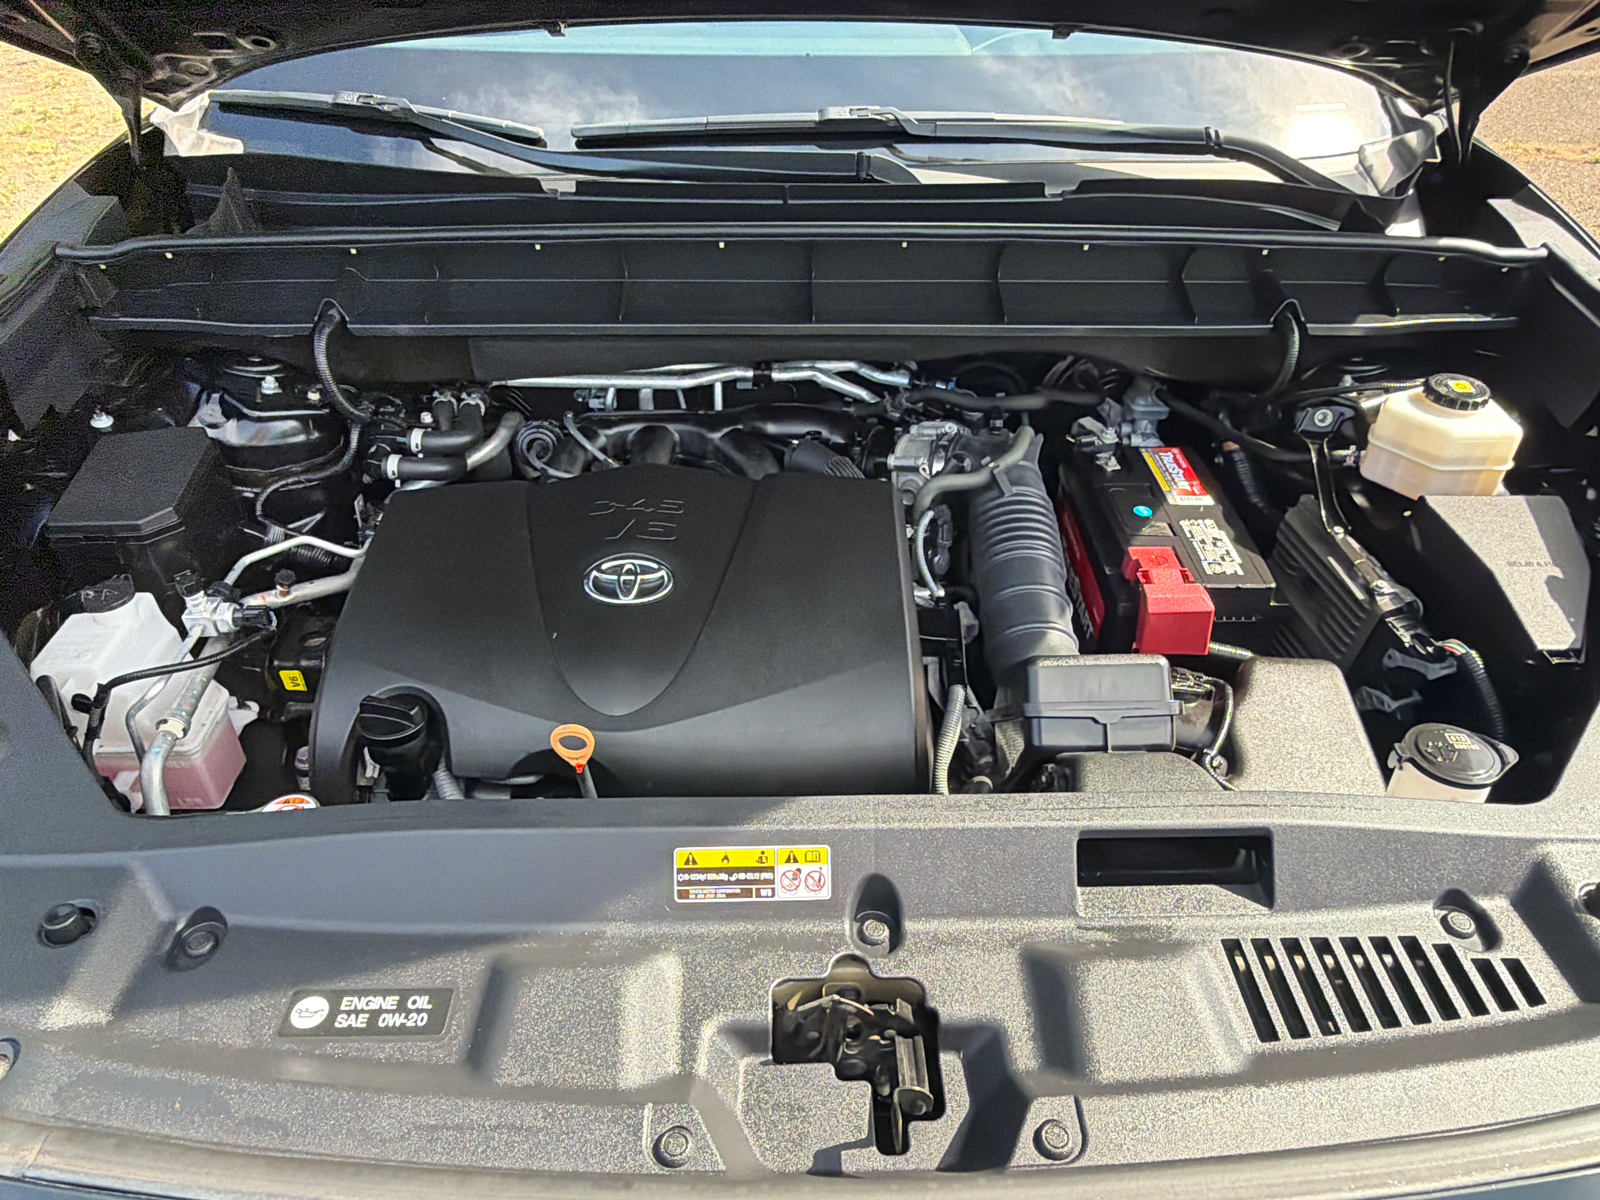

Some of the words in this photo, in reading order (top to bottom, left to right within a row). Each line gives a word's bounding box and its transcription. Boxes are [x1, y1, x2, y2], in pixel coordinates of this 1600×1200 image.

[289, 676, 301, 688] V6
[340, 996, 399, 1010] ENGINE
[407, 996, 432, 1009] OIL
[334, 1013, 369, 1028] SAE
[378, 1013, 428, 1027] 0W-20
